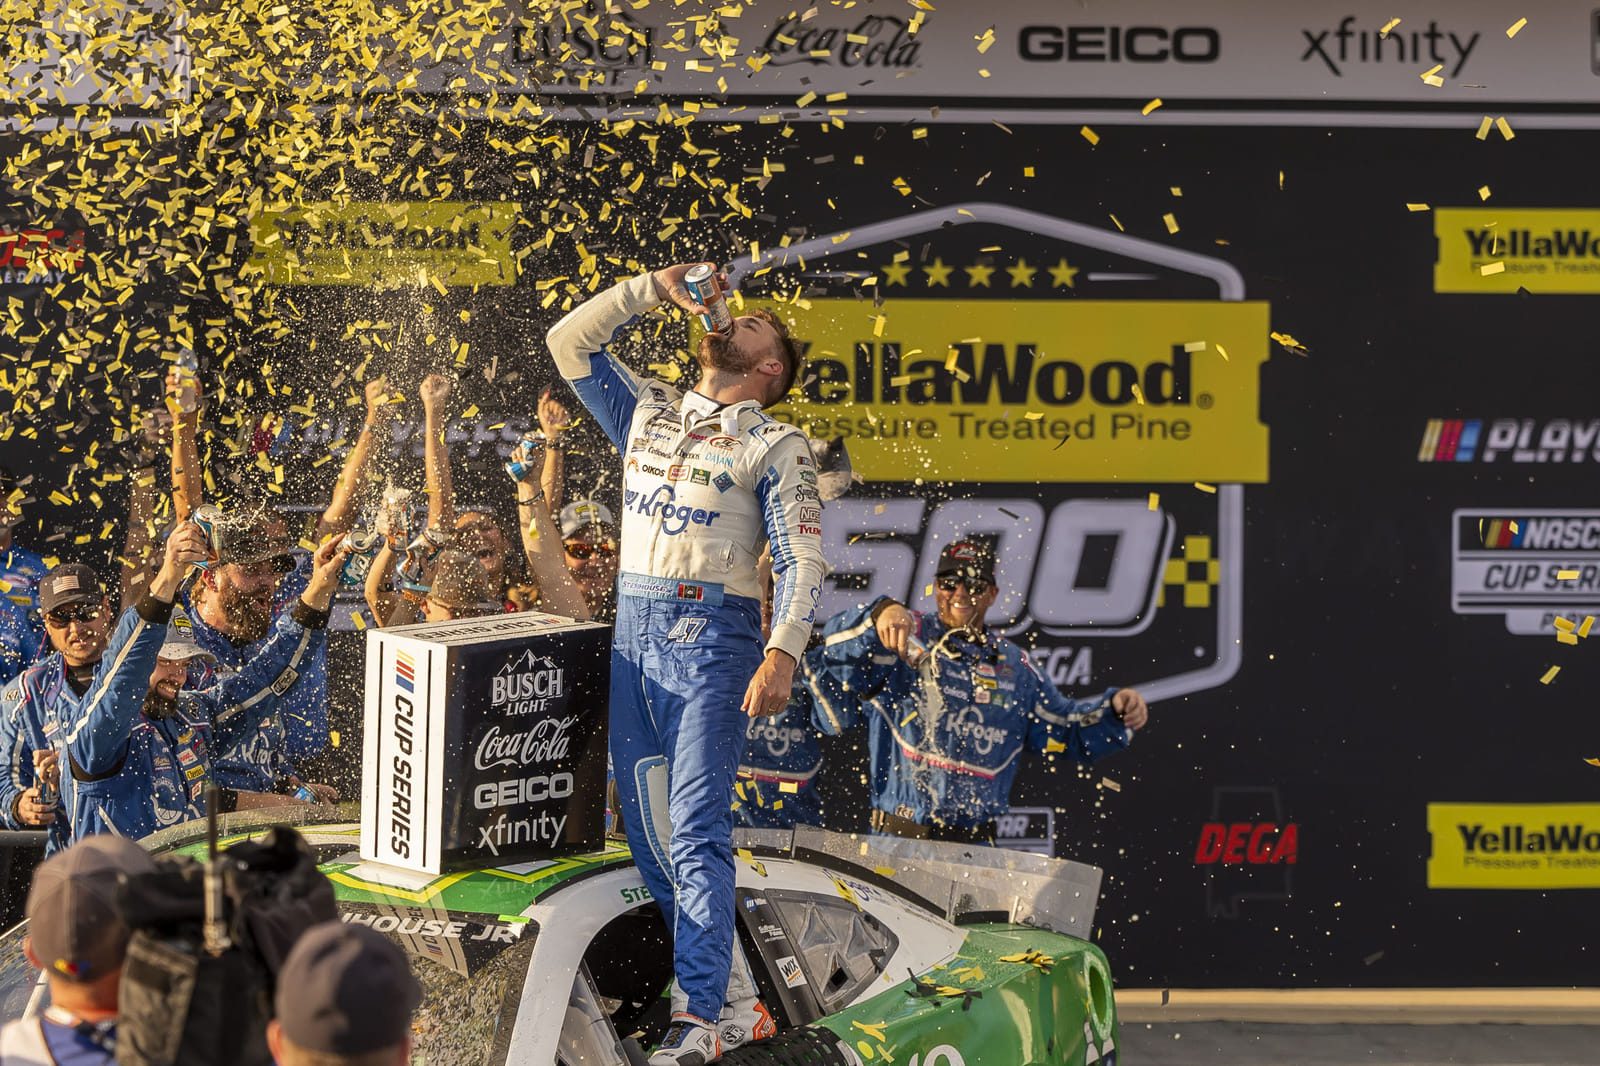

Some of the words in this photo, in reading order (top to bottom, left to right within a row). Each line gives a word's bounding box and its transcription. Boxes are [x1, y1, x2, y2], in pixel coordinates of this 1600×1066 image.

[1018, 26, 1221, 62] GEICO
[1300, 16, 1480, 77] xfinity
[799, 342, 1192, 407] ellaWood
[950, 411, 1096, 440] Treated
[1110, 411, 1191, 440] Pine
[642, 464, 666, 477] OIKOS
[637, 484, 721, 536] Kroger
[820, 498, 1167, 627] 500
[1484, 565, 1542, 590] CUP
[667, 617, 708, 643] 47
[491, 667, 564, 707] BUSCH
[504, 699, 548, 716] LIGHT
[394, 693, 414, 756] CUP
[945, 705, 1009, 755] Kroger
[391, 755, 412, 860] SERIES
[474, 772, 574, 810] GEICO
[477, 810, 568, 856] xfinity
[1195, 823, 1299, 865] DEGA
[781, 958, 799, 978] WIX
